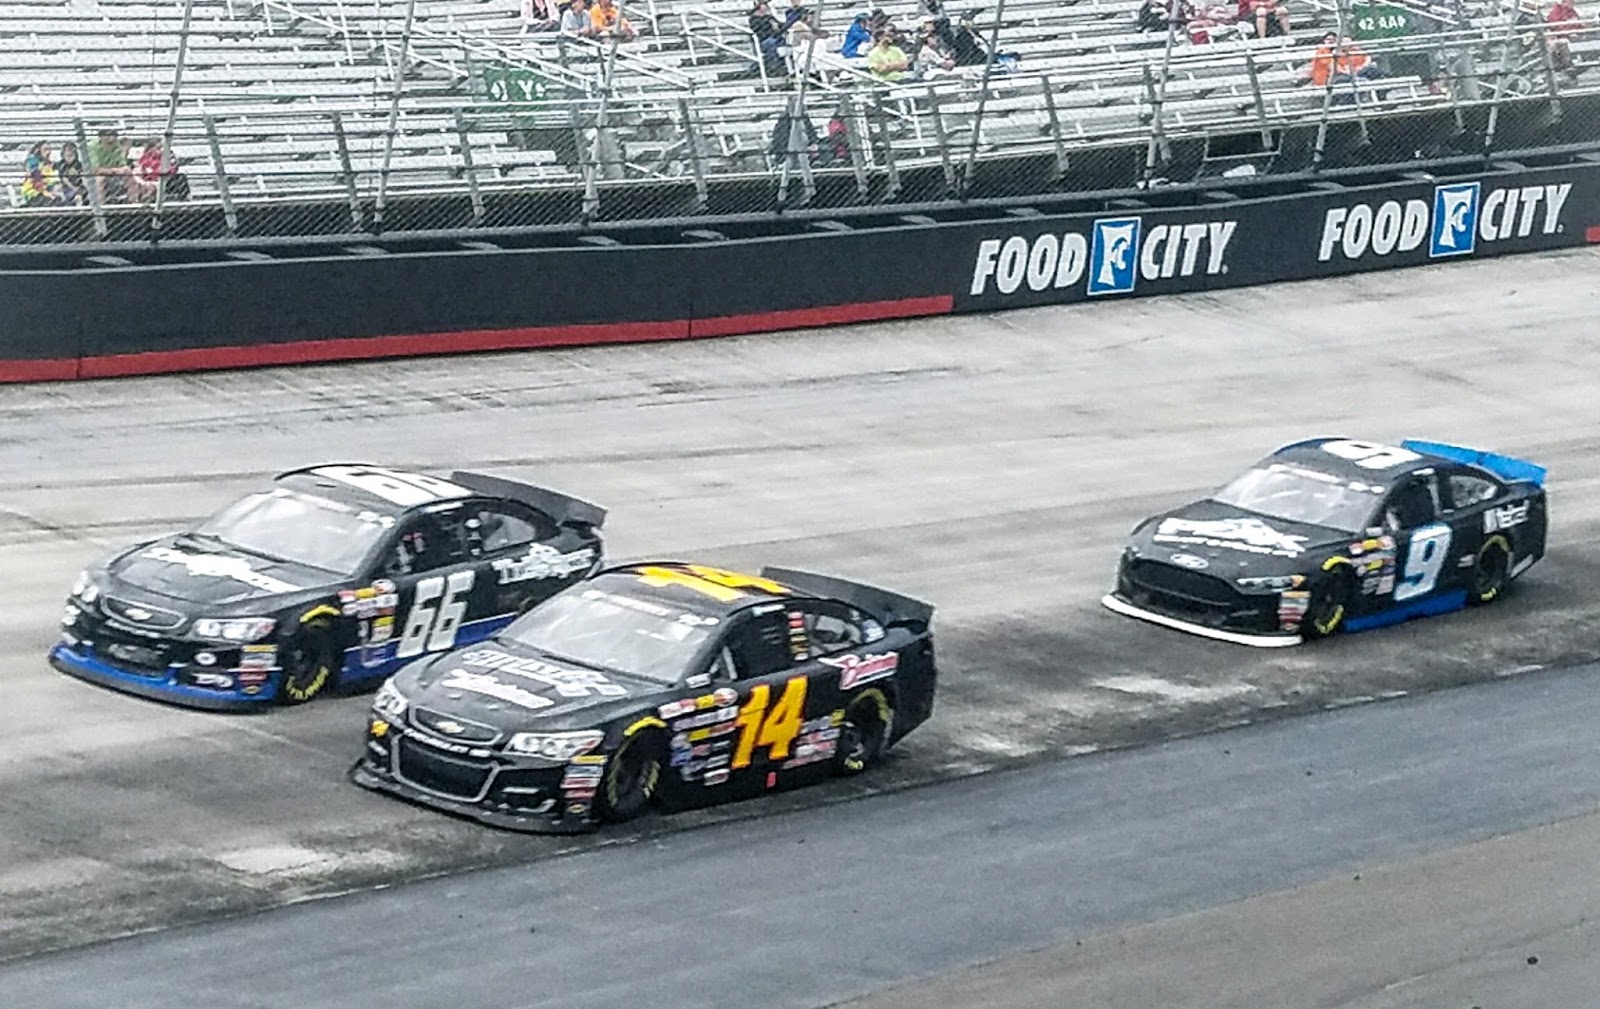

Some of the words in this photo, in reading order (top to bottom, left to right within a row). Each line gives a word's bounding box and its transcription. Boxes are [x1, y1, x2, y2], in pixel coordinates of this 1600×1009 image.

[970, 232, 1088, 296] FOOD
[1140, 221, 1237, 281] CITY
[1318, 199, 1429, 261] FOOD
[1479, 183, 1572, 241] CITY
[1393, 523, 1453, 601] 9
[396, 570, 476, 658] 66
[731, 674, 809, 770] 14
